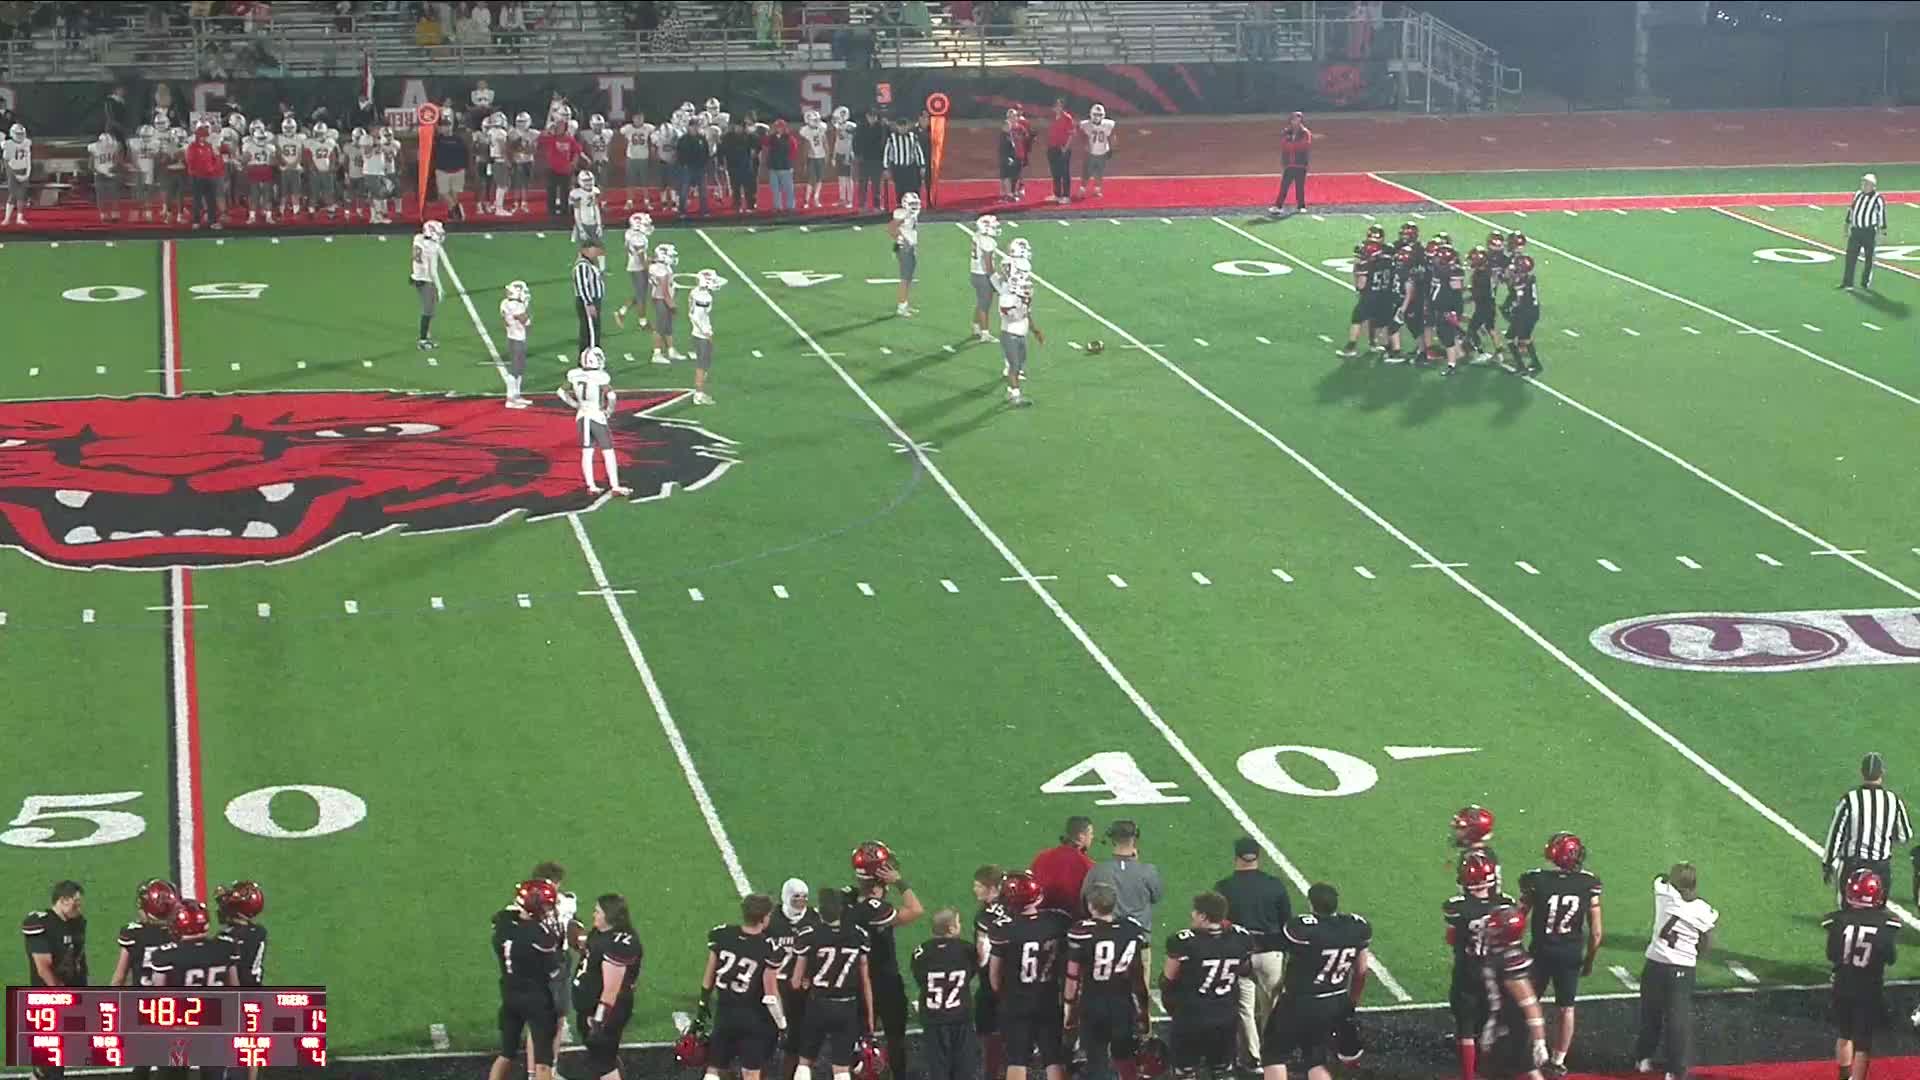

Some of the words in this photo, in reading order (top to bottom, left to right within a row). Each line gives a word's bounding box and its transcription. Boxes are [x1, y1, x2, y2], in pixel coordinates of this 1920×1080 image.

[1544, 894, 1581, 935] 12
[812, 946, 860, 989] 27
[1092, 938, 1138, 982] 84
[1842, 924, 1879, 968] 15
[715, 949, 759, 994] 23
[926, 968, 967, 1010] 52
[1198, 957, 1242, 996] 75
